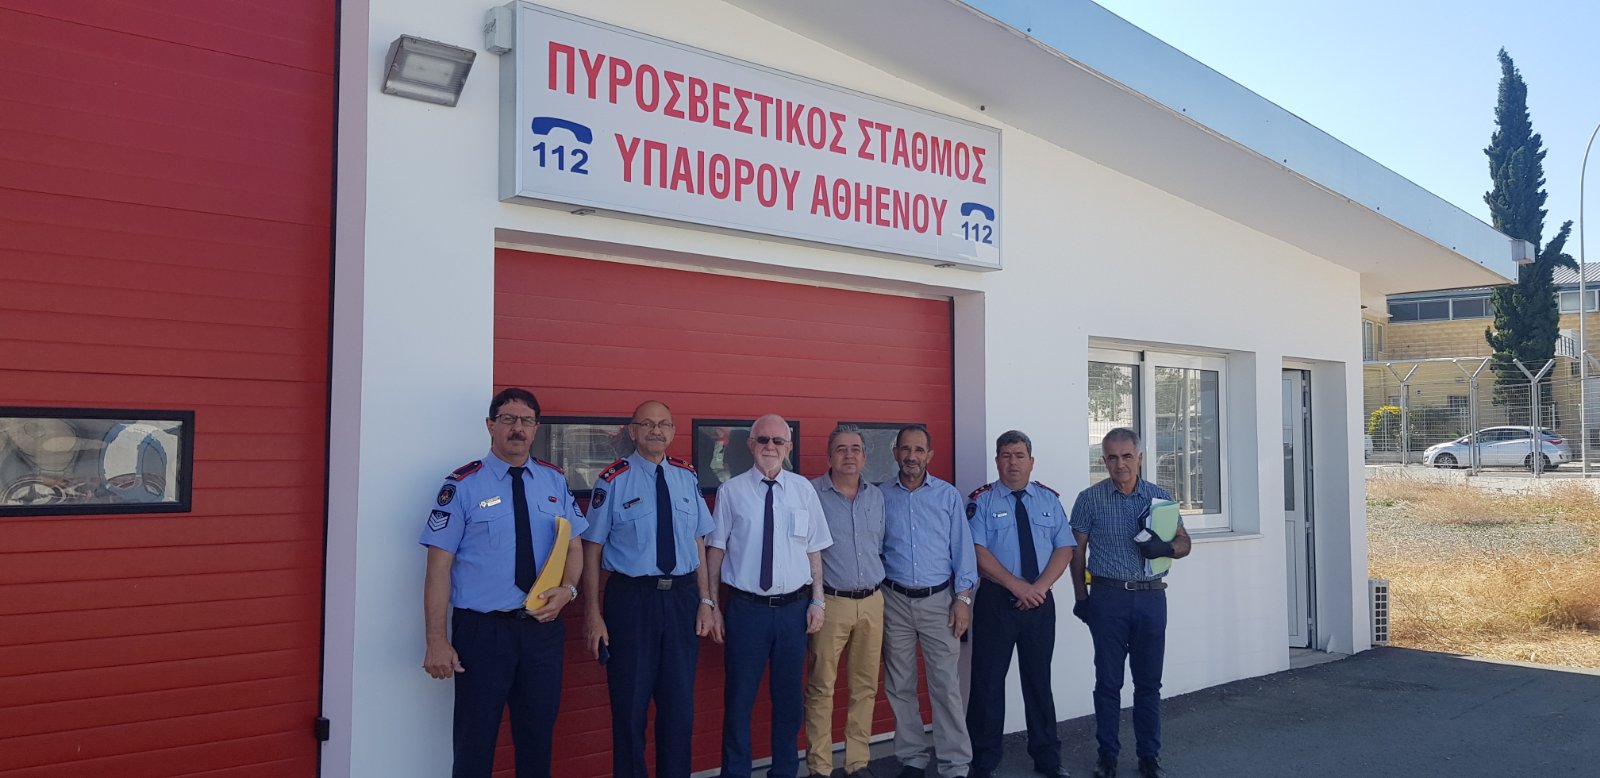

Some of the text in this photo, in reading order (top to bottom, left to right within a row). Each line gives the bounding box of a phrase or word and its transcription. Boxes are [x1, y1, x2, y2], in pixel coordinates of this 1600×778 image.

[548, 41, 987, 185] ΠΥΡΟΣΒΕΣΤΙΚΟΣ ΣΤΑΘΜΟΣ
[531, 140, 590, 176] 112
[615, 133, 949, 236] ΥΠΑΙΘΡΟΥ ΑΘΗΕΝΟΥ
[960, 220, 993, 245] 112
